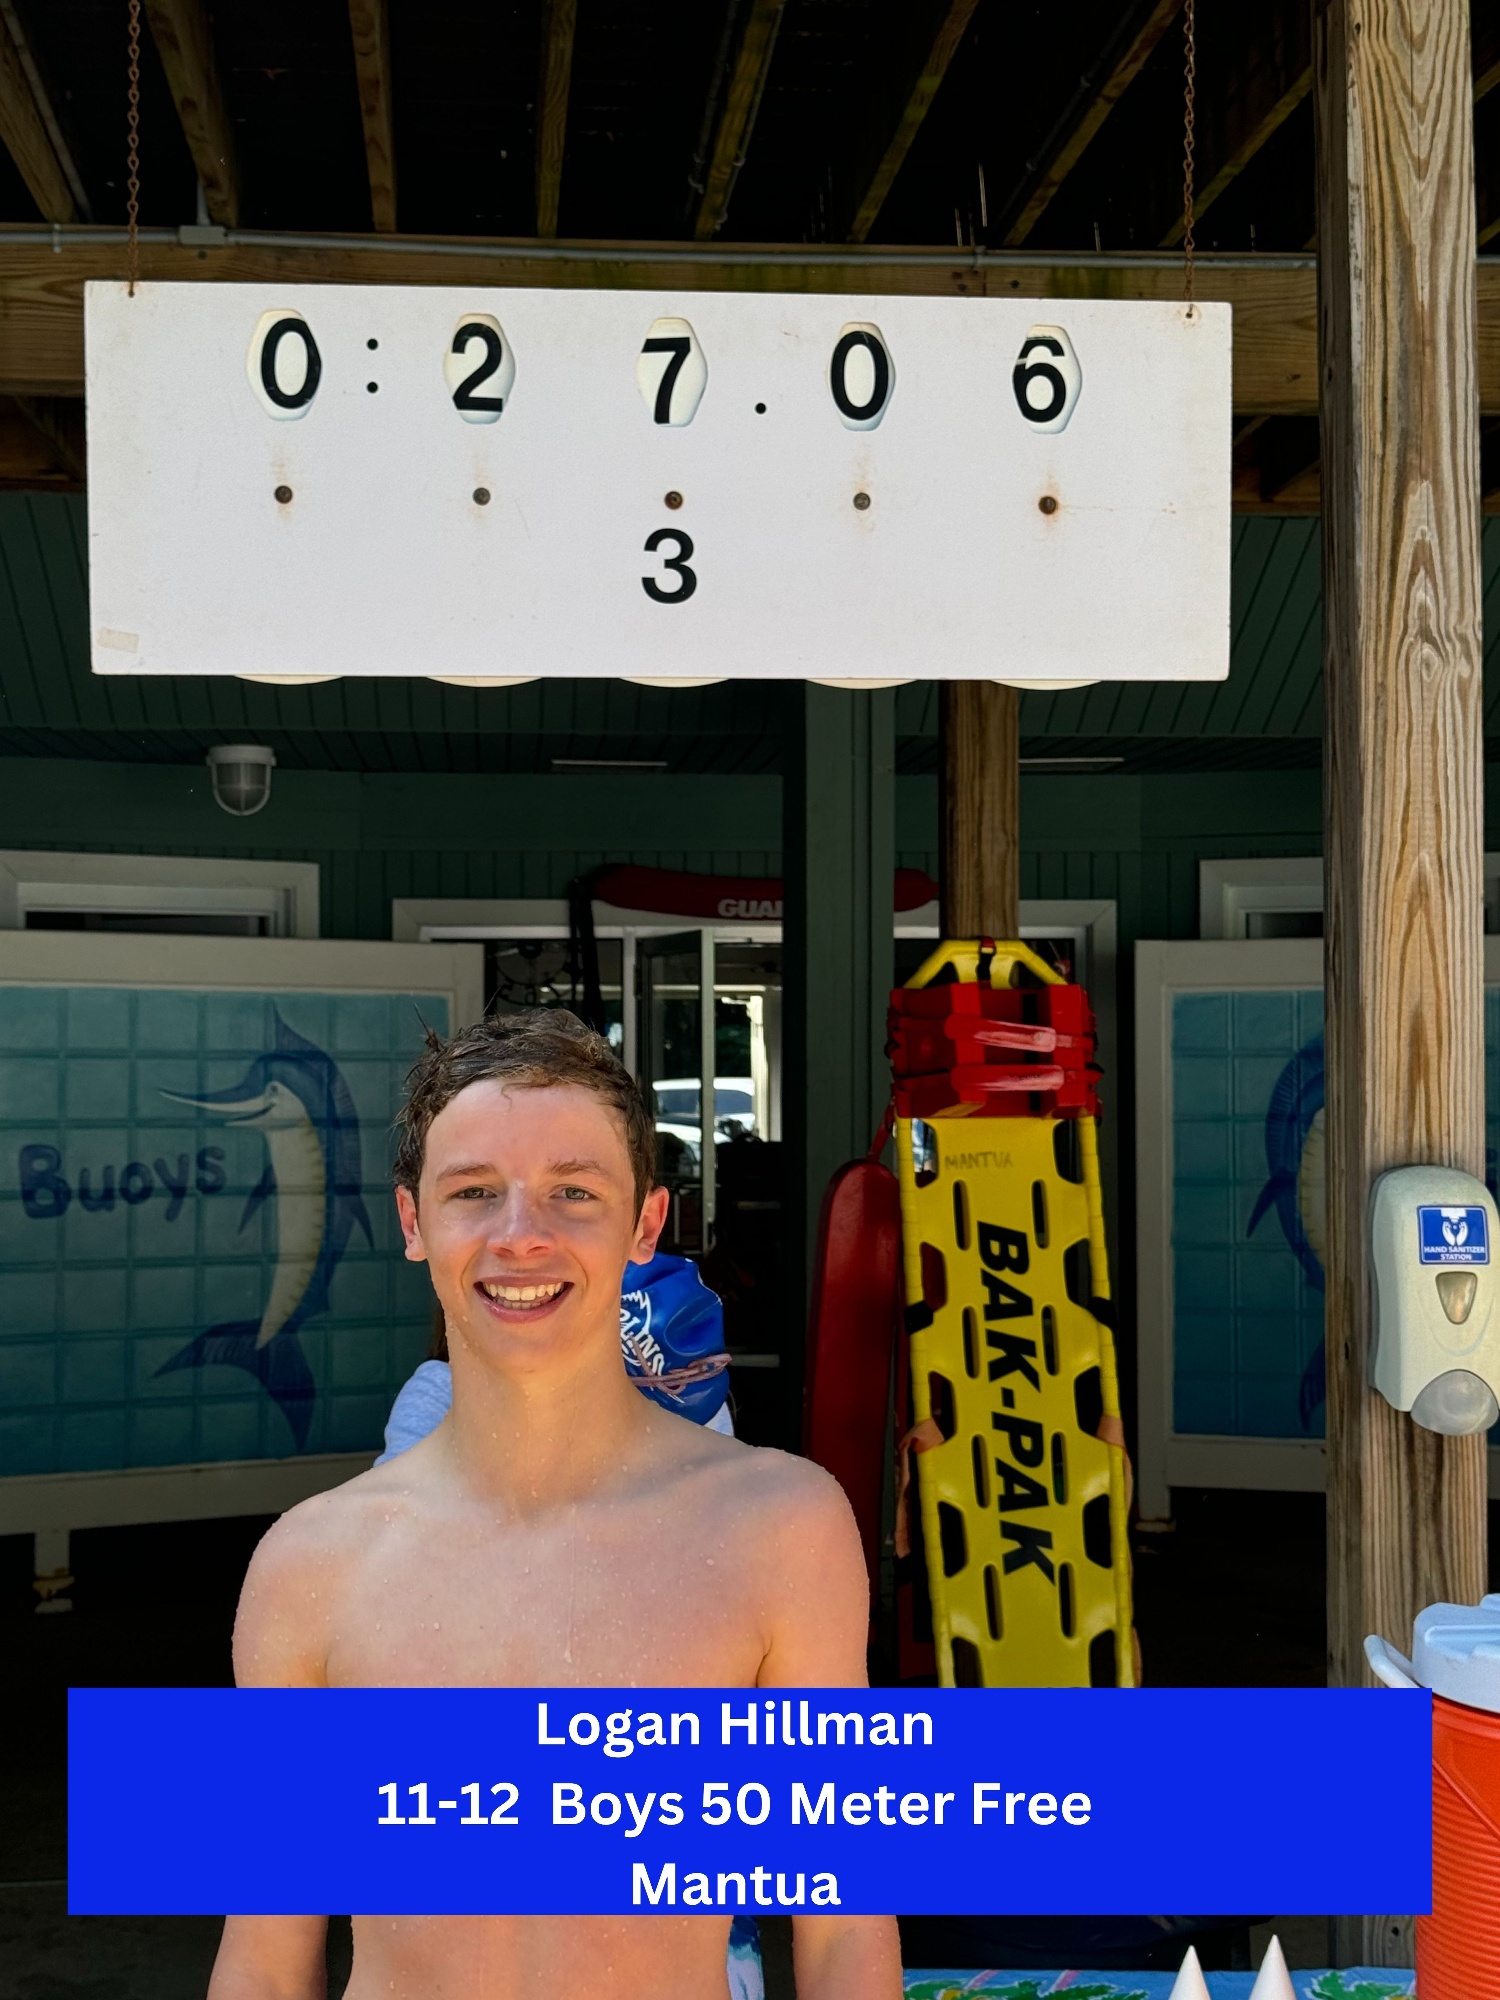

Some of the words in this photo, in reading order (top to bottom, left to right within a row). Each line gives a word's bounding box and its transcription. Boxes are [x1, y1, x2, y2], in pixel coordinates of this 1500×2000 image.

[641, 528, 698, 604] 3
[19, 1143, 227, 1222] Buoys
[944, 1150, 1015, 1170] MANTUA
[1423, 1246, 1447, 1254] HAND
[1448, 1246, 1485, 1254] SANITIZER
[1440, 1253, 1472, 1261] STATION
[977, 1220, 1056, 1587] BAK-PAK
